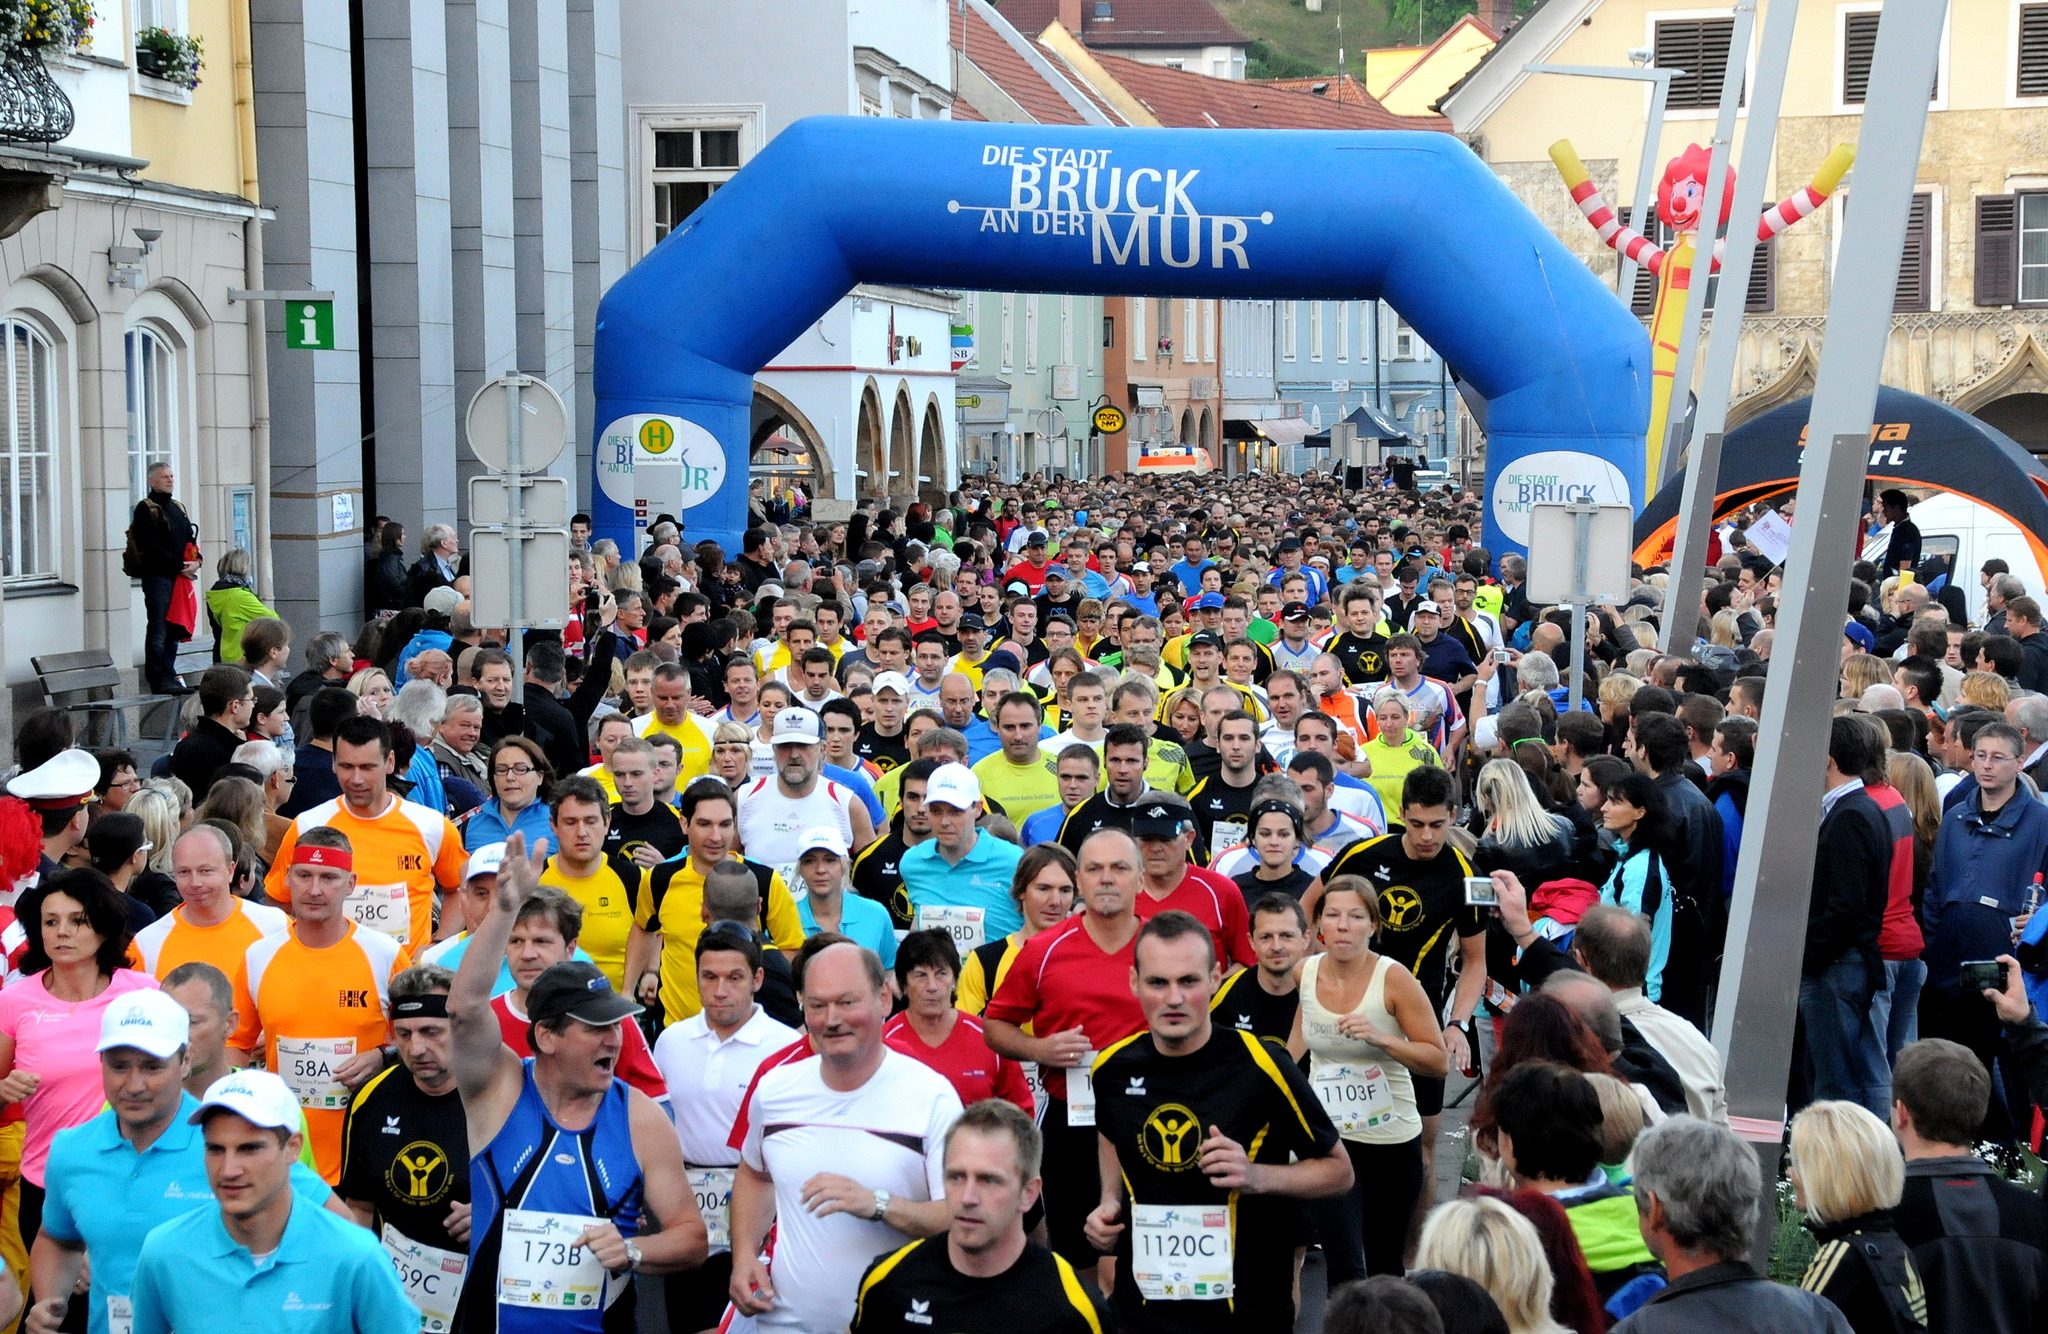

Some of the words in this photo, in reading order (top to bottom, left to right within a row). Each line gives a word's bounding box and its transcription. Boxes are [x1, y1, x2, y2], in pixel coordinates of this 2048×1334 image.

[982, 145, 1024, 166] DIE
[1032, 147, 1112, 169] STADT
[1010, 163, 1200, 217] BRUCK
[980, 209, 1019, 234] AN
[1032, 210, 1086, 236] DER
[1091, 212, 1250, 269] MUR
[608, 436, 619, 446] DIE
[648, 426, 665, 447] H
[607, 463, 620, 474] AN
[623, 464, 634, 474] DE
[1508, 474, 1523, 485] DIE
[1526, 475, 1558, 486] STADT
[1507, 503, 1522, 512] AN
[355, 904, 388, 920] 58C
[294, 1060, 331, 1077] 58A
[1323, 1084, 1376, 1103] 1103F
[524, 1240, 582, 1266] 173B
[1143, 1234, 1215, 1257] 1120C
